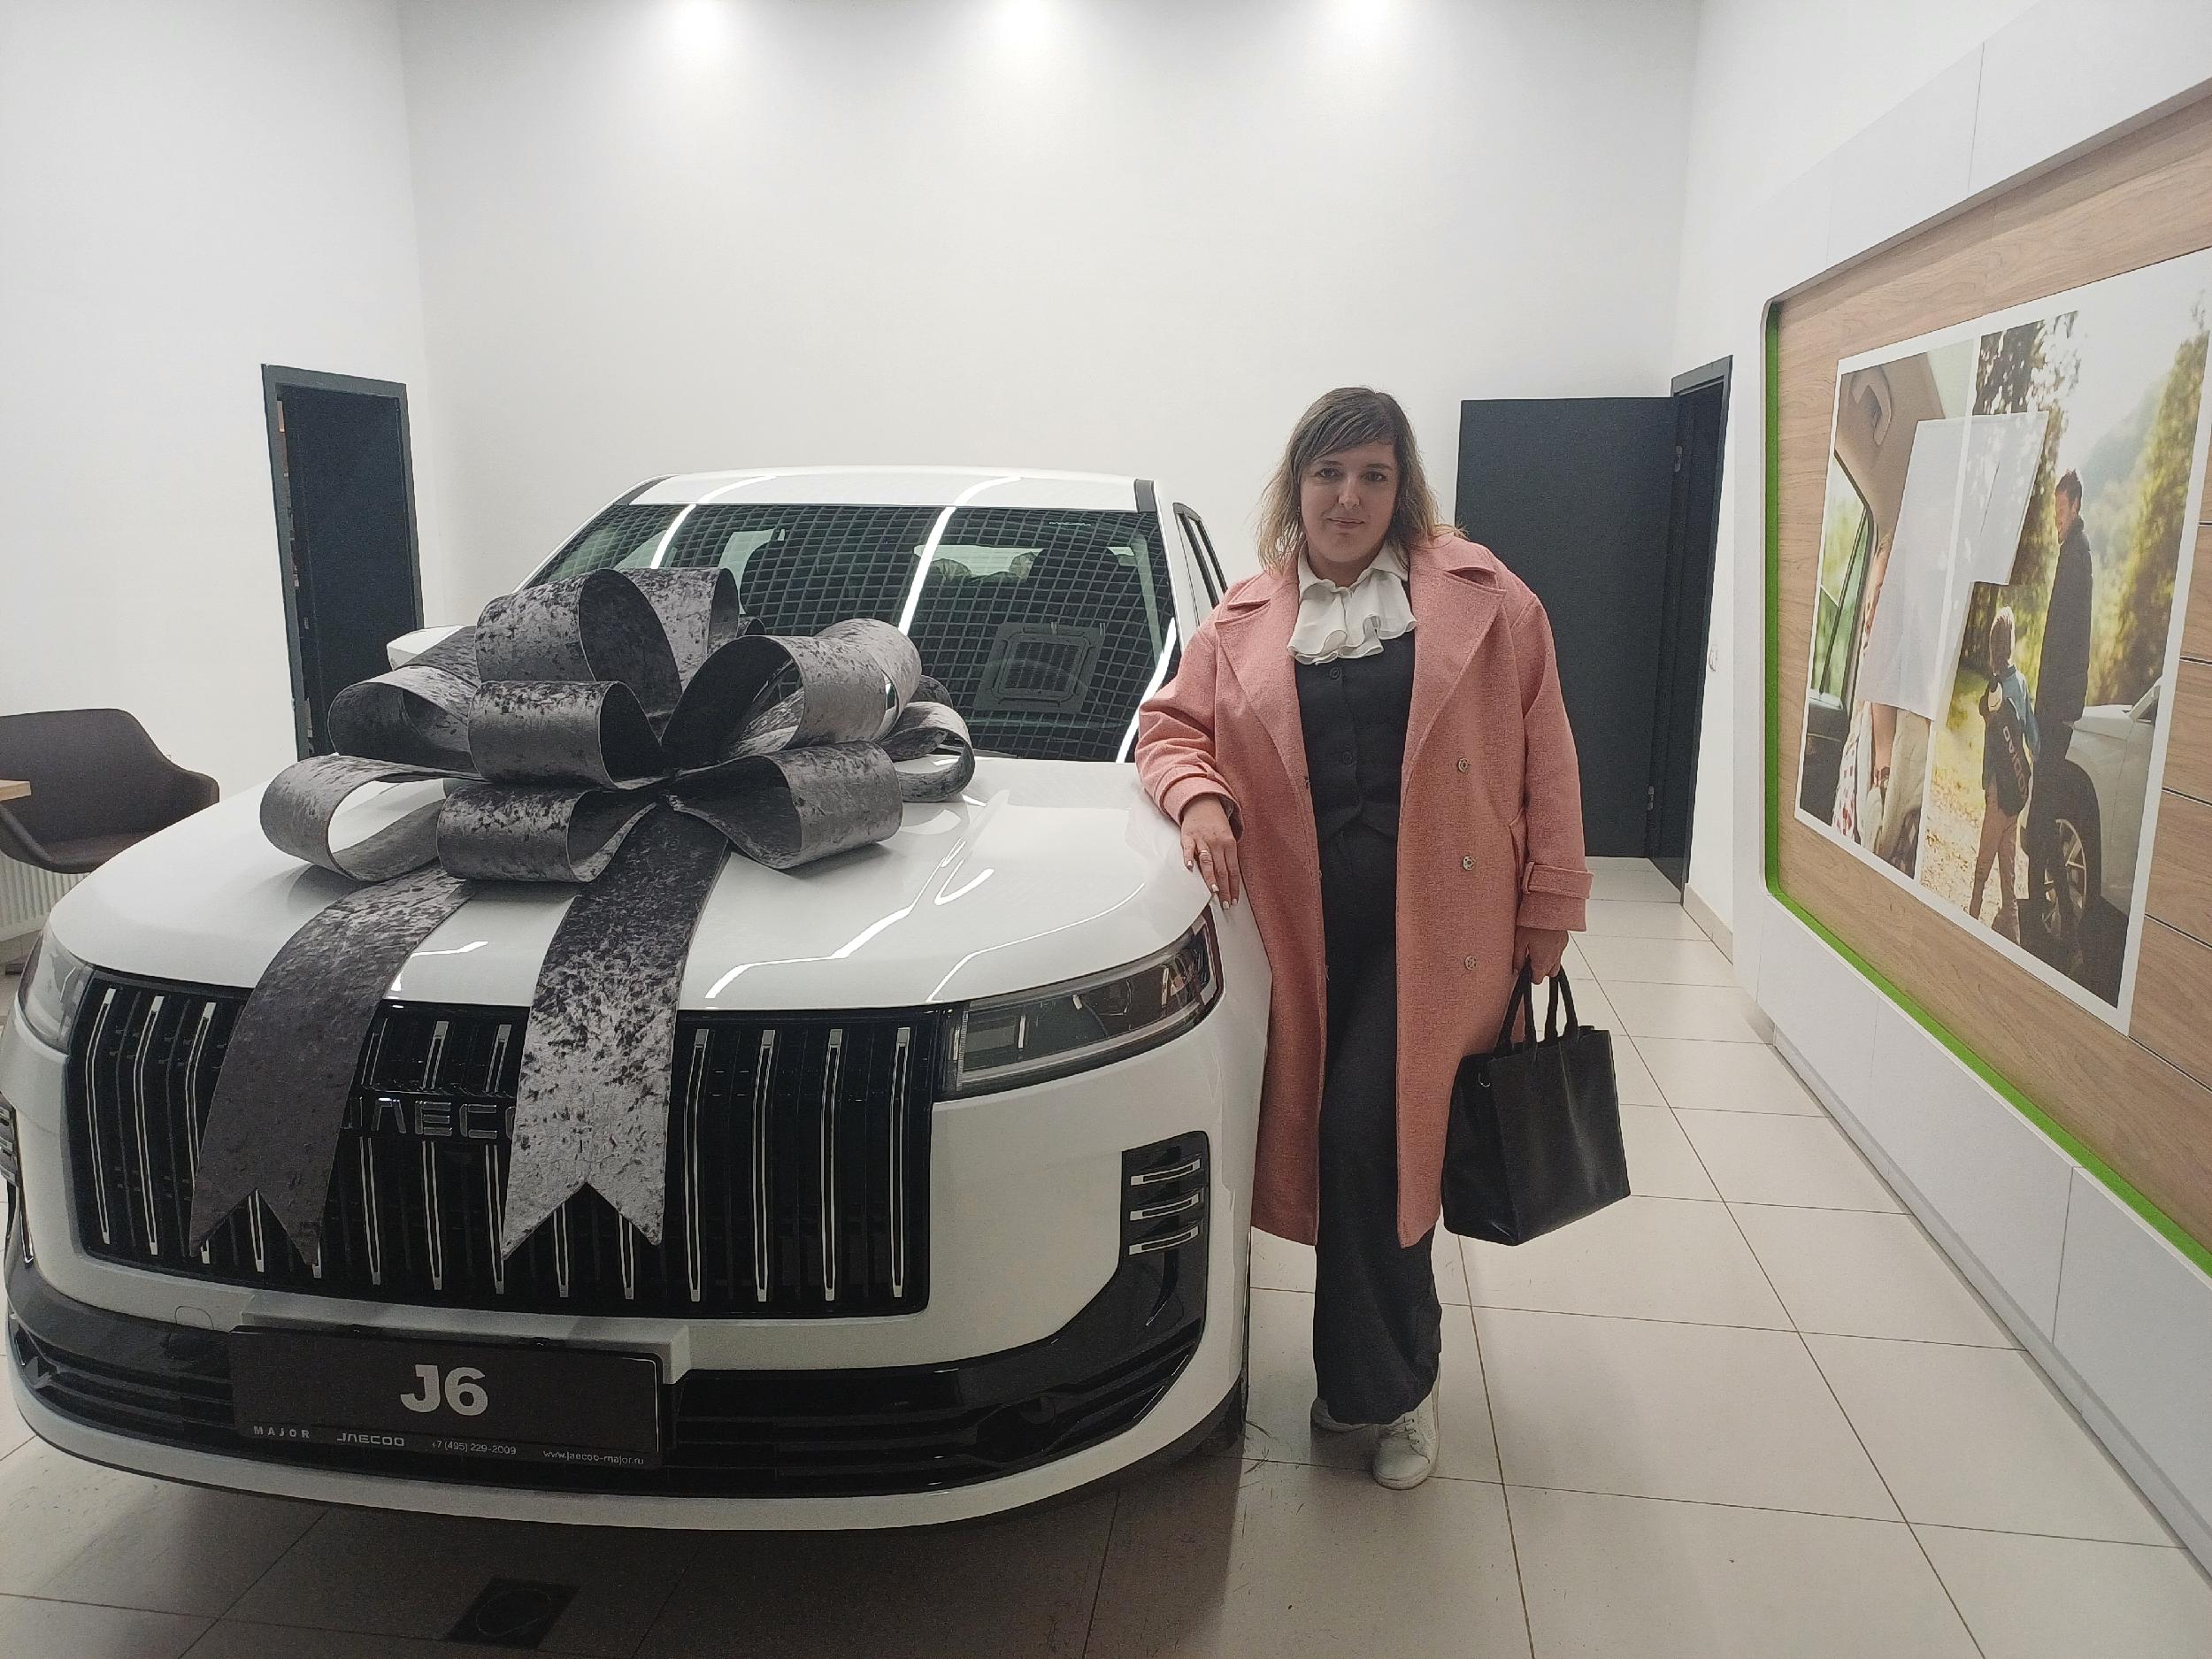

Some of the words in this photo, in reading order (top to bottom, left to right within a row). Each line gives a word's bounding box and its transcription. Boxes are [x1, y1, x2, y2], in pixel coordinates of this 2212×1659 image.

[400, 1363, 488, 1416] J6
[253, 1425, 311, 1439] MAJOR
[336, 1432, 404, 1447] JAECOO
[432, 1440, 442, 1449] +7
[444, 1440, 468, 1453] (495)
[470, 1443, 517, 1455] 229-2009
[542, 1450, 645, 1466] www.jaecoo-major.ru
